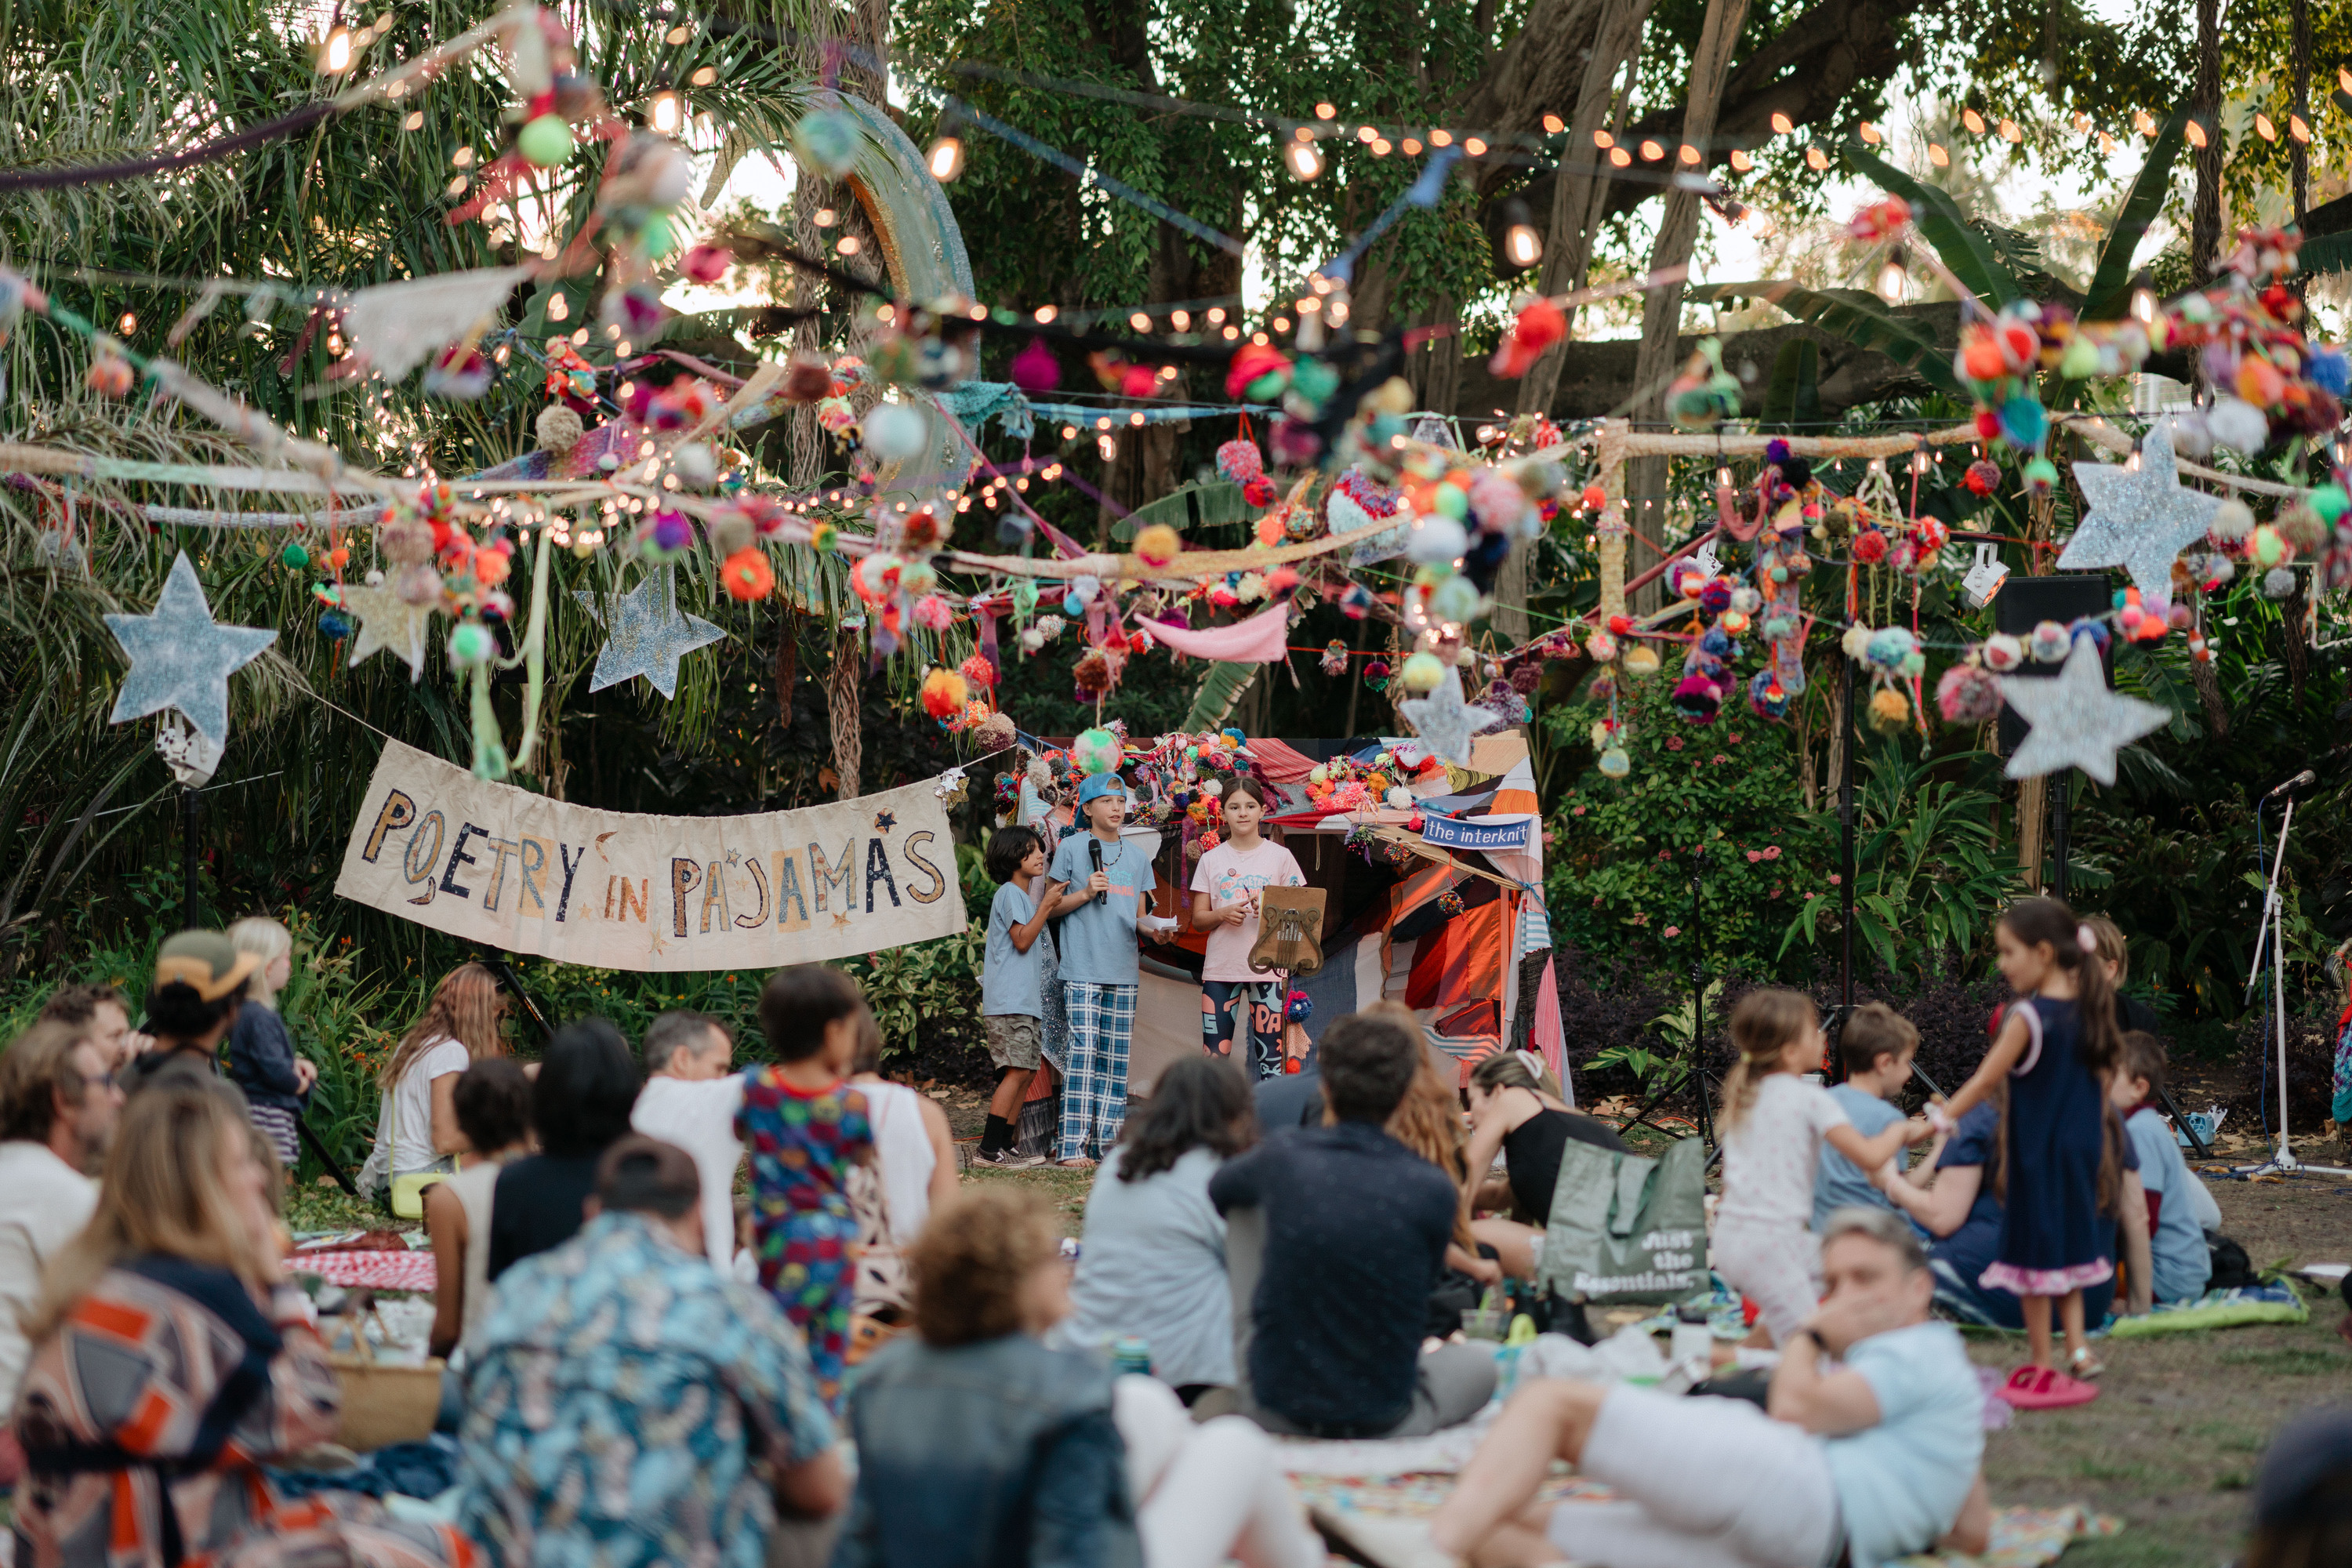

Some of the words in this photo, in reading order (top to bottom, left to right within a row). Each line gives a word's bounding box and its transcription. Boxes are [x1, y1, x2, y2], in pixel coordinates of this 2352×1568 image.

[1428, 821, 1454, 840] the
[1461, 826, 1527, 844] interknit
[361, 788, 585, 923] POETRY
[604, 874, 649, 924] IN
[671, 830, 946, 938] PAJAMAS
[1653, 1250, 1694, 1270] the
